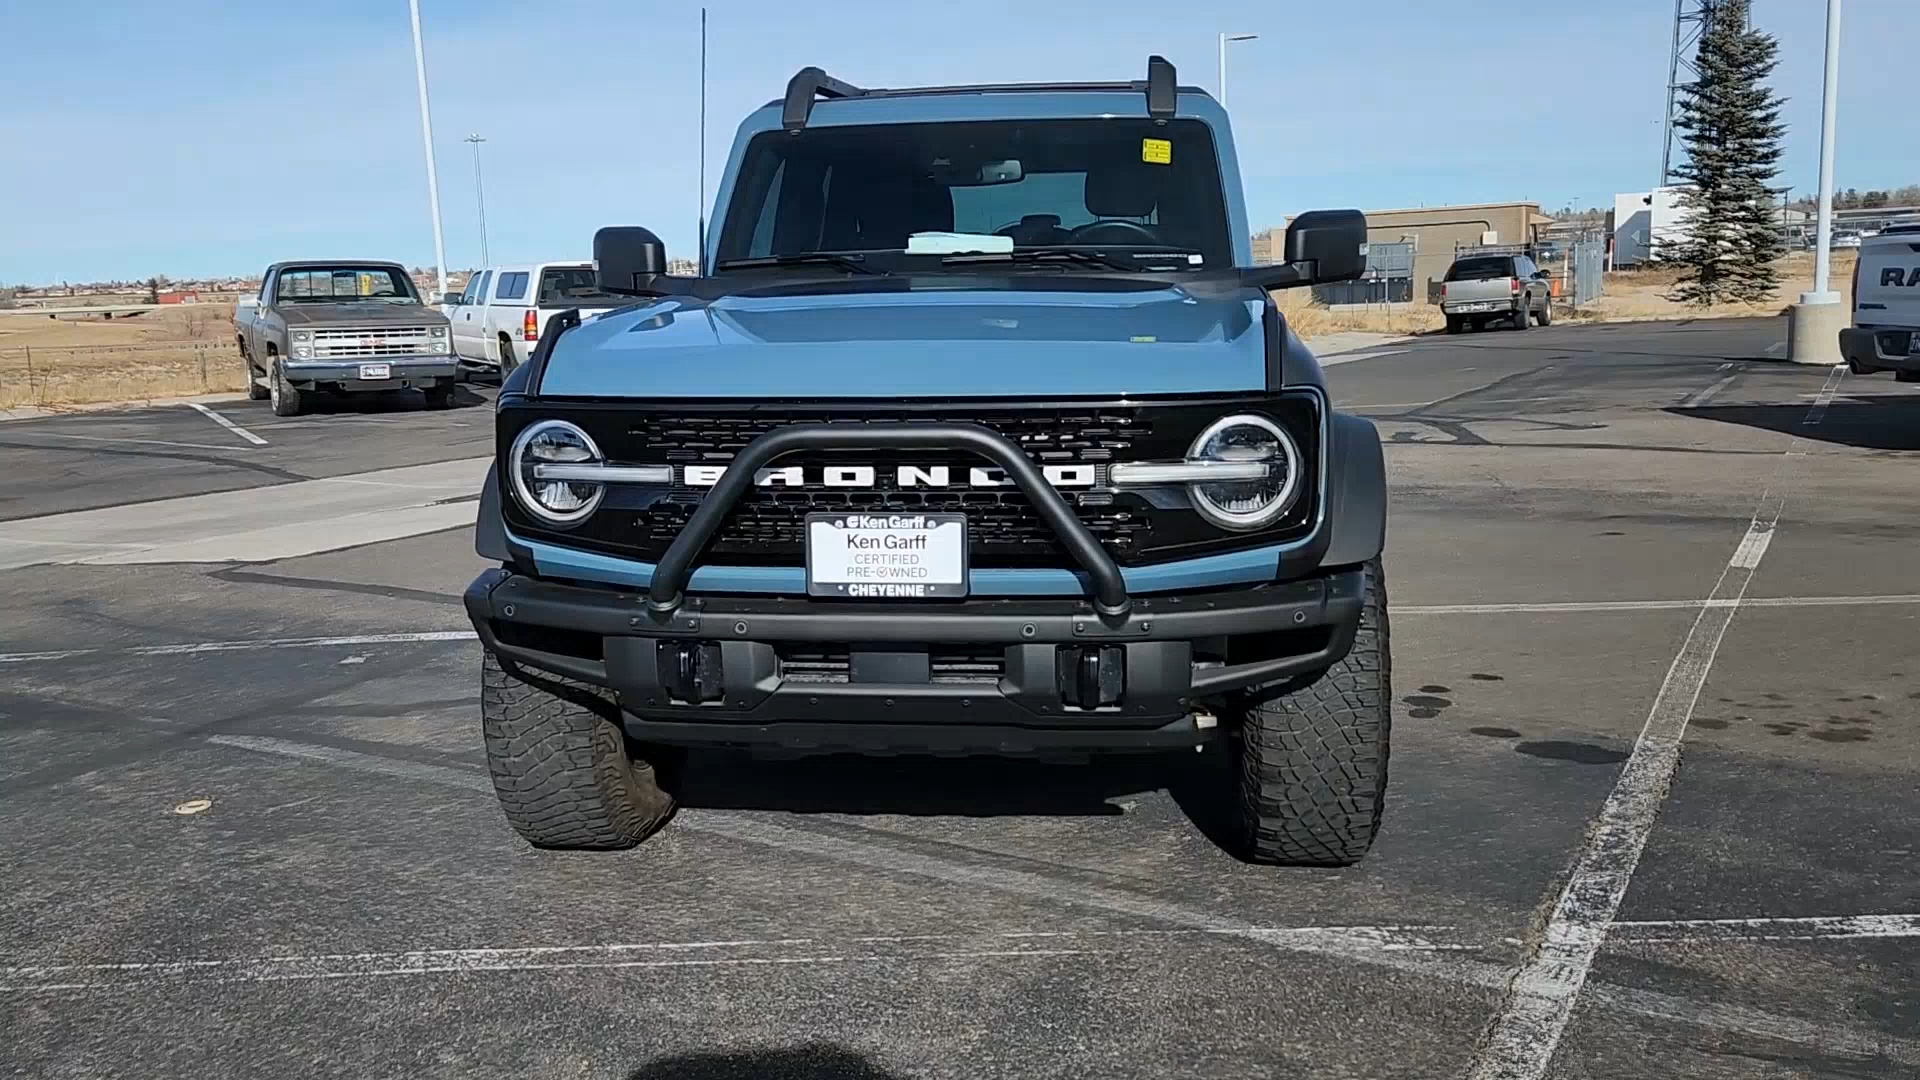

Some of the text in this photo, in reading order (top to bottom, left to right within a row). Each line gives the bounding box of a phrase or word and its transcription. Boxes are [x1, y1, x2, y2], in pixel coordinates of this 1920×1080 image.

[684, 465, 1095, 487] BRONCO
[847, 534, 928, 549] Ken Garff
[854, 553, 920, 565] CERTIFIED
[848, 584, 925, 597] CHEYENNE
